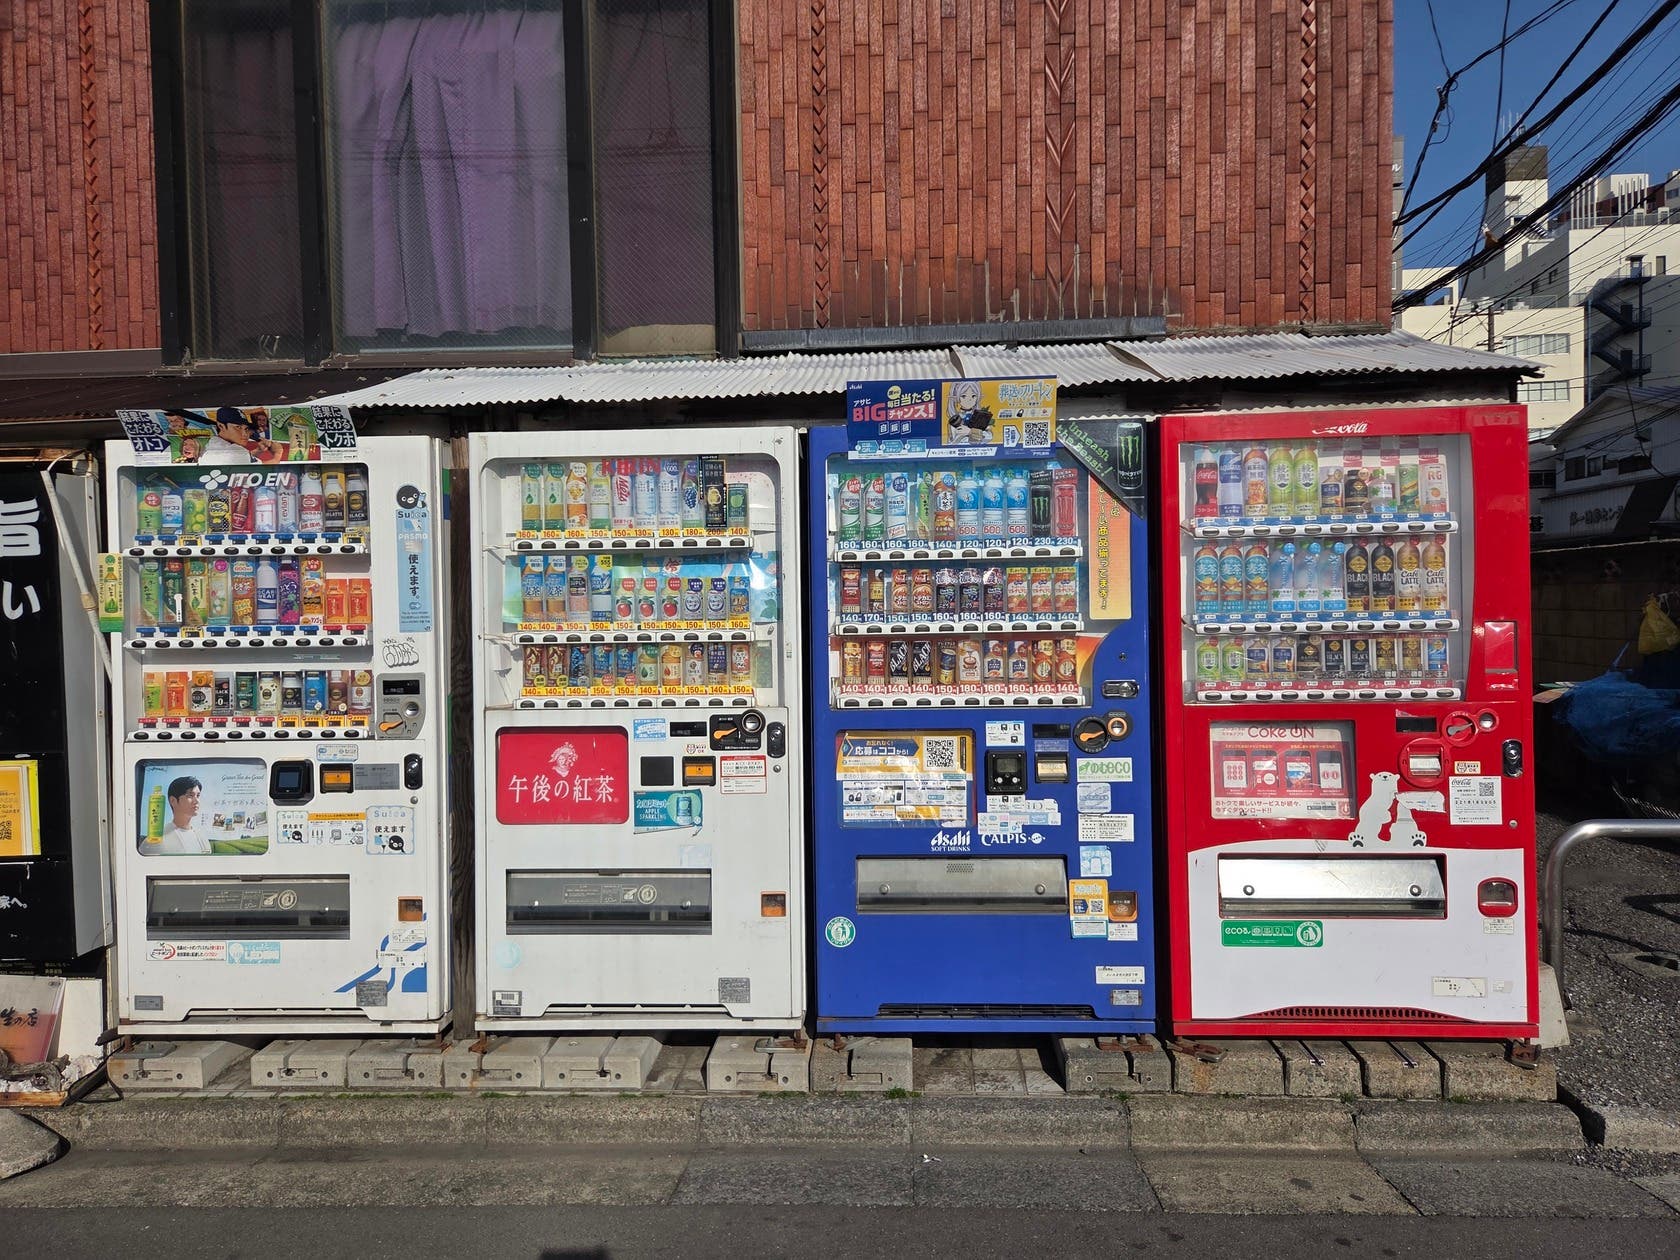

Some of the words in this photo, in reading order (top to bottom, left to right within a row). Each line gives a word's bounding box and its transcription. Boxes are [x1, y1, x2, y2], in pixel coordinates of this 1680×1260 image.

[853, 398, 871, 407] アサヒ
[120, 411, 149, 422] 結果に
[311, 406, 341, 417] 結果に
[853, 403, 886, 422] BIG
[126, 423, 160, 434] こだわる
[317, 420, 352, 430] こだわる
[134, 438, 164, 451] オトコ
[325, 433, 355, 447] トクホ
[1069, 422, 1110, 461] Unleash
[228, 472, 262, 489] ITO
[264, 472, 291, 488] EN
[397, 511, 428, 519] Suica
[408, 554, 421, 600] 使えます。
[1400, 577, 1420, 585] LATTE
[1426, 576, 1445, 584] LATTE
[890, 642, 908, 673] BLACK
[912, 641, 932, 672] BLACK
[1247, 725, 1287, 739] Coke
[1290, 723, 1315, 738] ON
[855, 746, 909, 755] 応募はココから!
[508, 774, 614, 803] 午後の紅茶
[374, 809, 406, 818] Suica
[374, 825, 406, 834] 使えます
[930, 830, 971, 846] Asahi
[981, 832, 1028, 847] CALPIS
